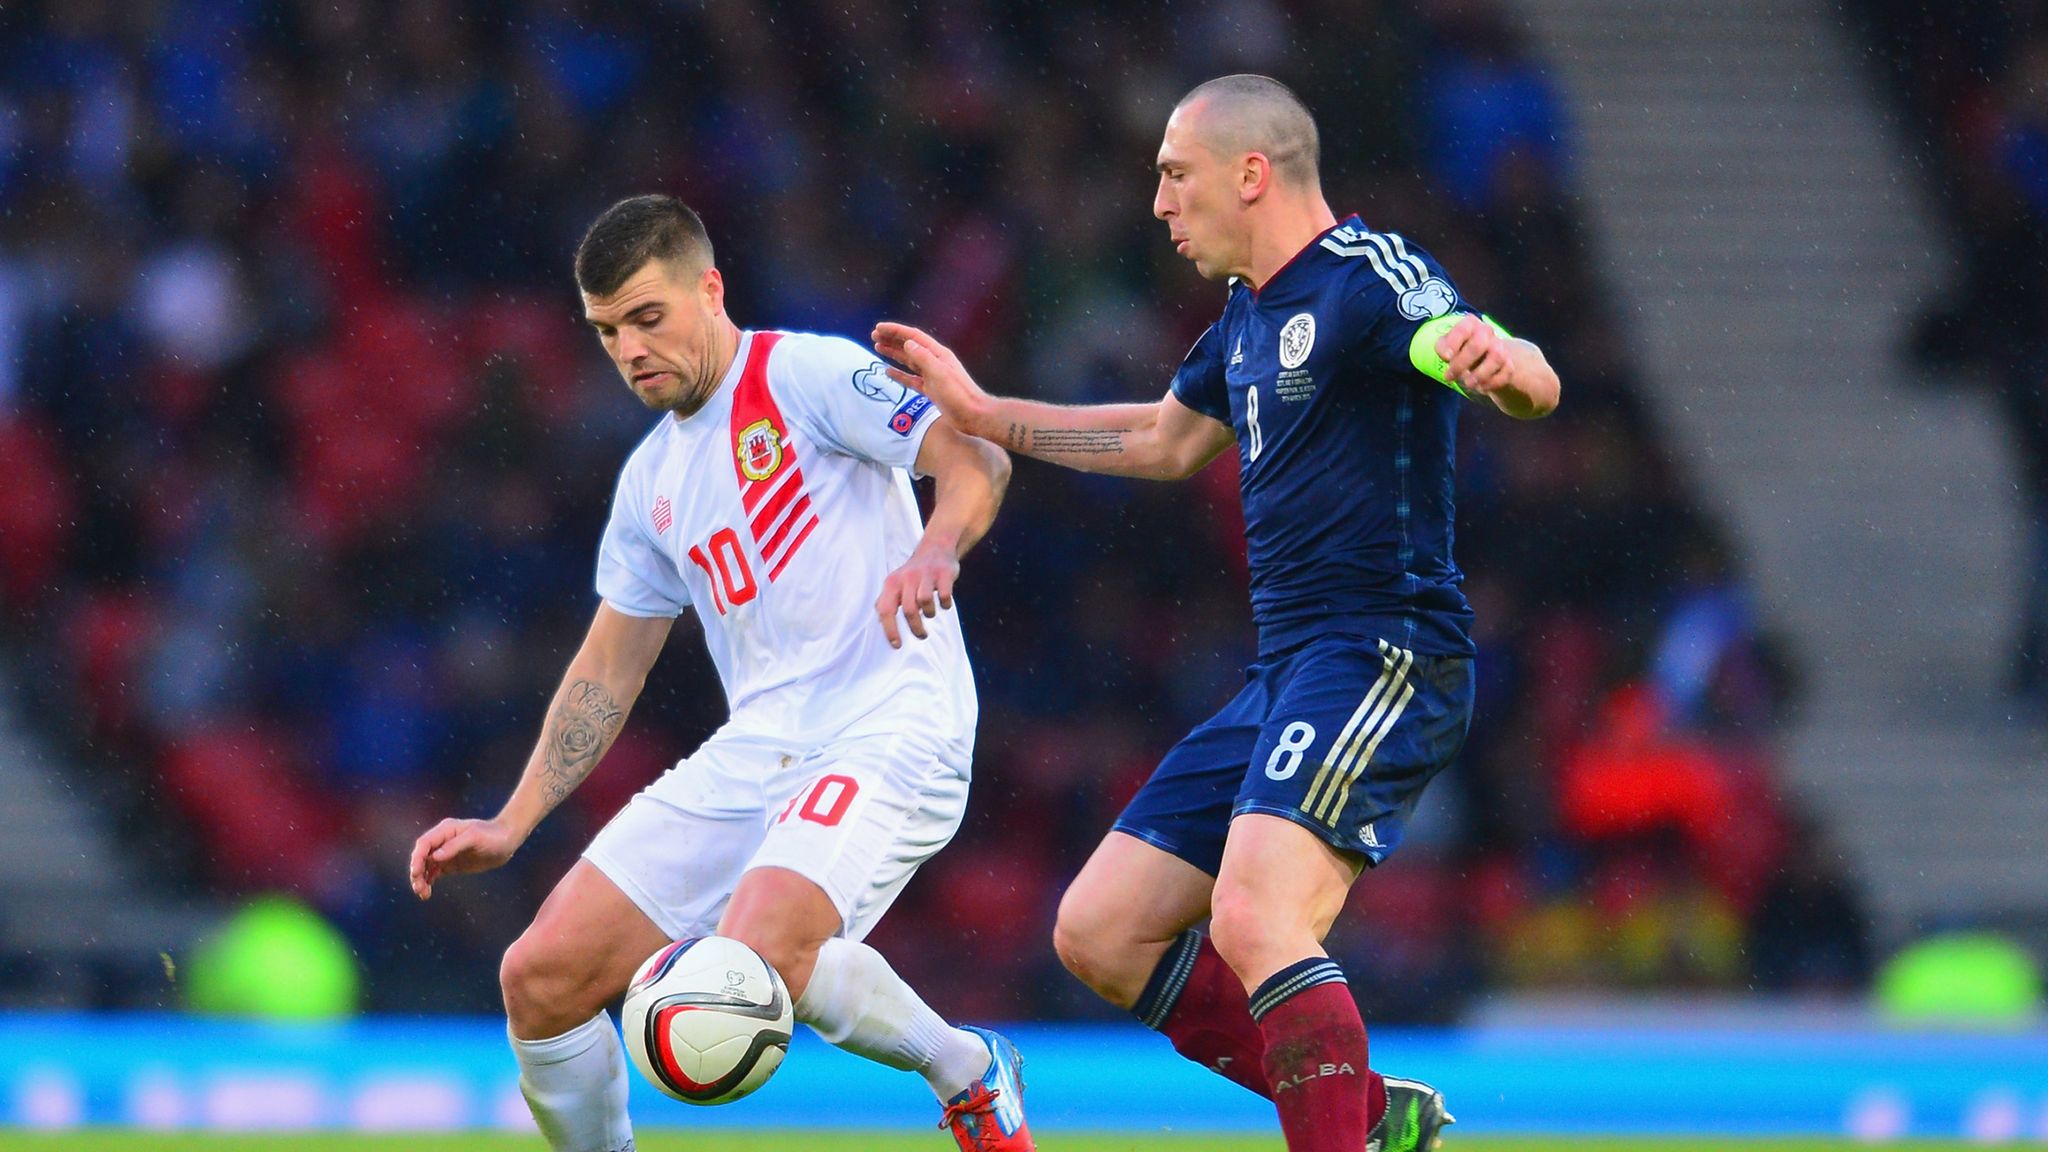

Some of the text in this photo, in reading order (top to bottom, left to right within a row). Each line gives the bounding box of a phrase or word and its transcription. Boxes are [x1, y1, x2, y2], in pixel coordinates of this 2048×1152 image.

[1247, 384, 1263, 463] 8
[688, 526, 758, 616] 10
[1264, 720, 1316, 781] 8
[1276, 1062, 1355, 1094] ALBA
